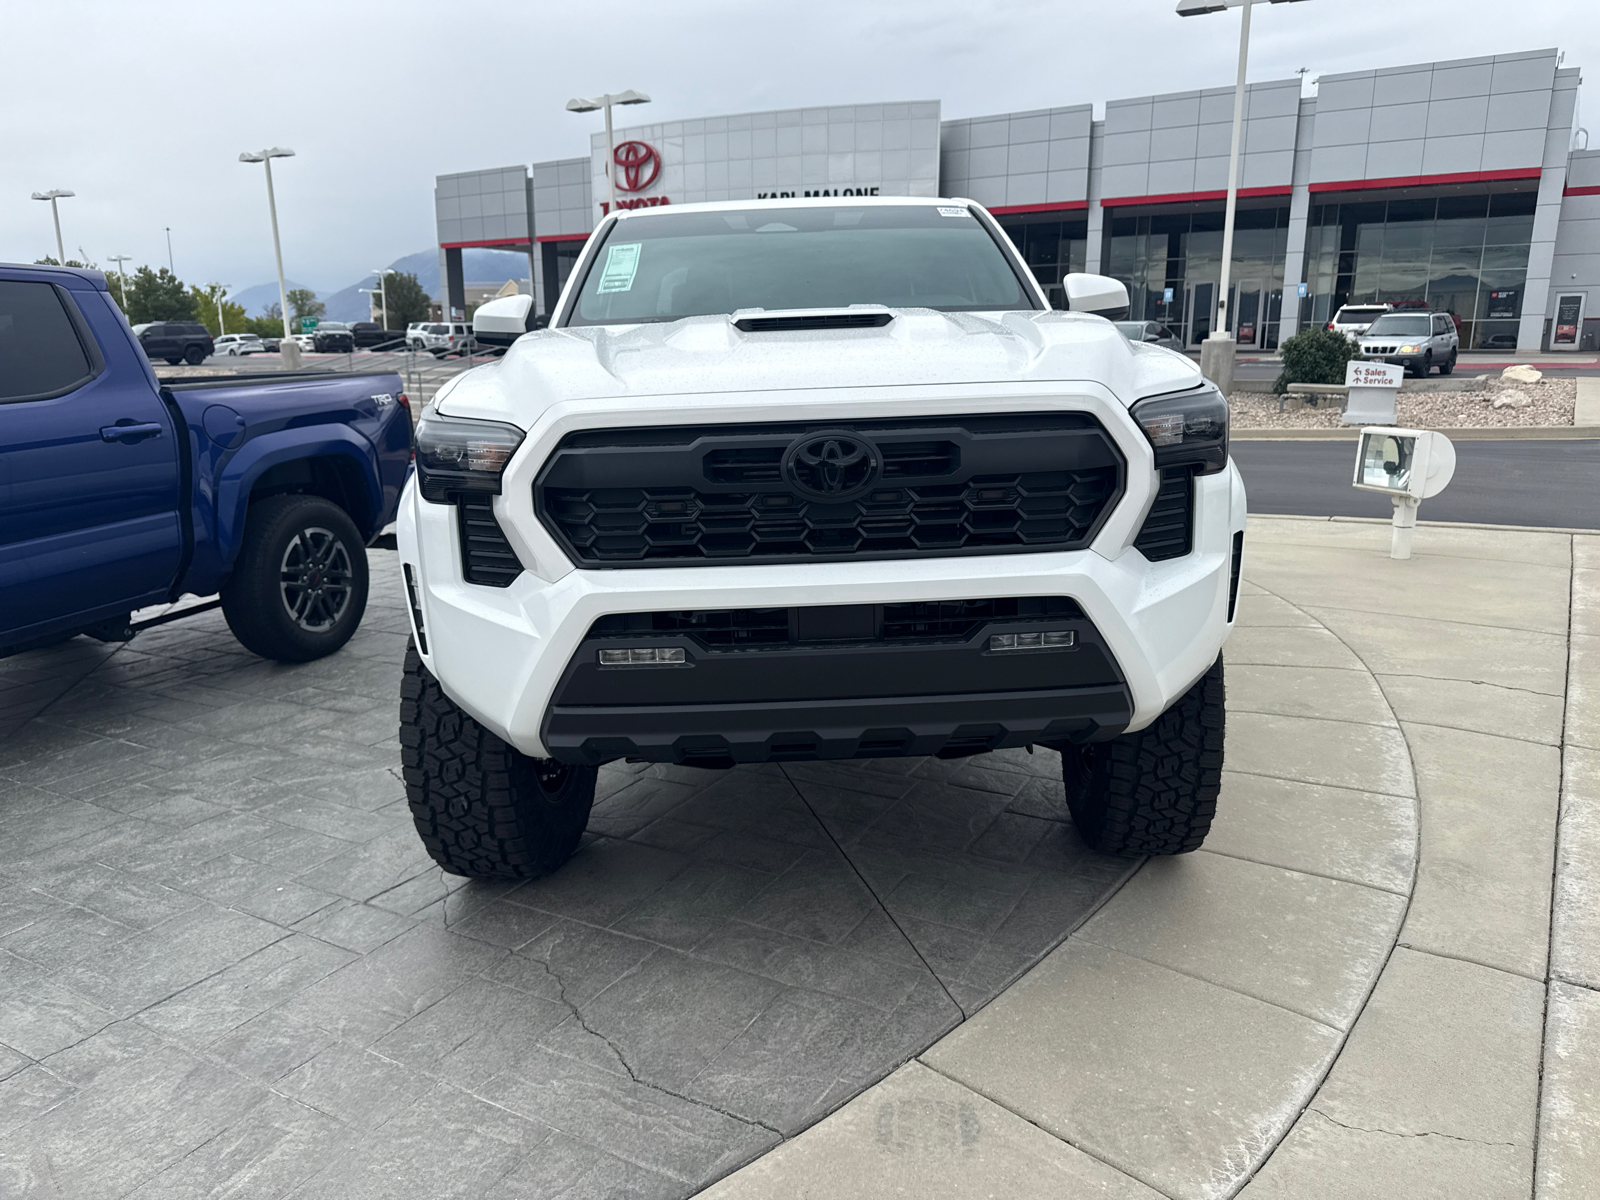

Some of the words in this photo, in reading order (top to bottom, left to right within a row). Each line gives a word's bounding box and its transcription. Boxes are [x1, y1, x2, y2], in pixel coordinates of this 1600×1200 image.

[599, 195, 670, 217] TYOTA
[1364, 368, 1387, 376] Sales
[1363, 376, 1394, 385] Service
